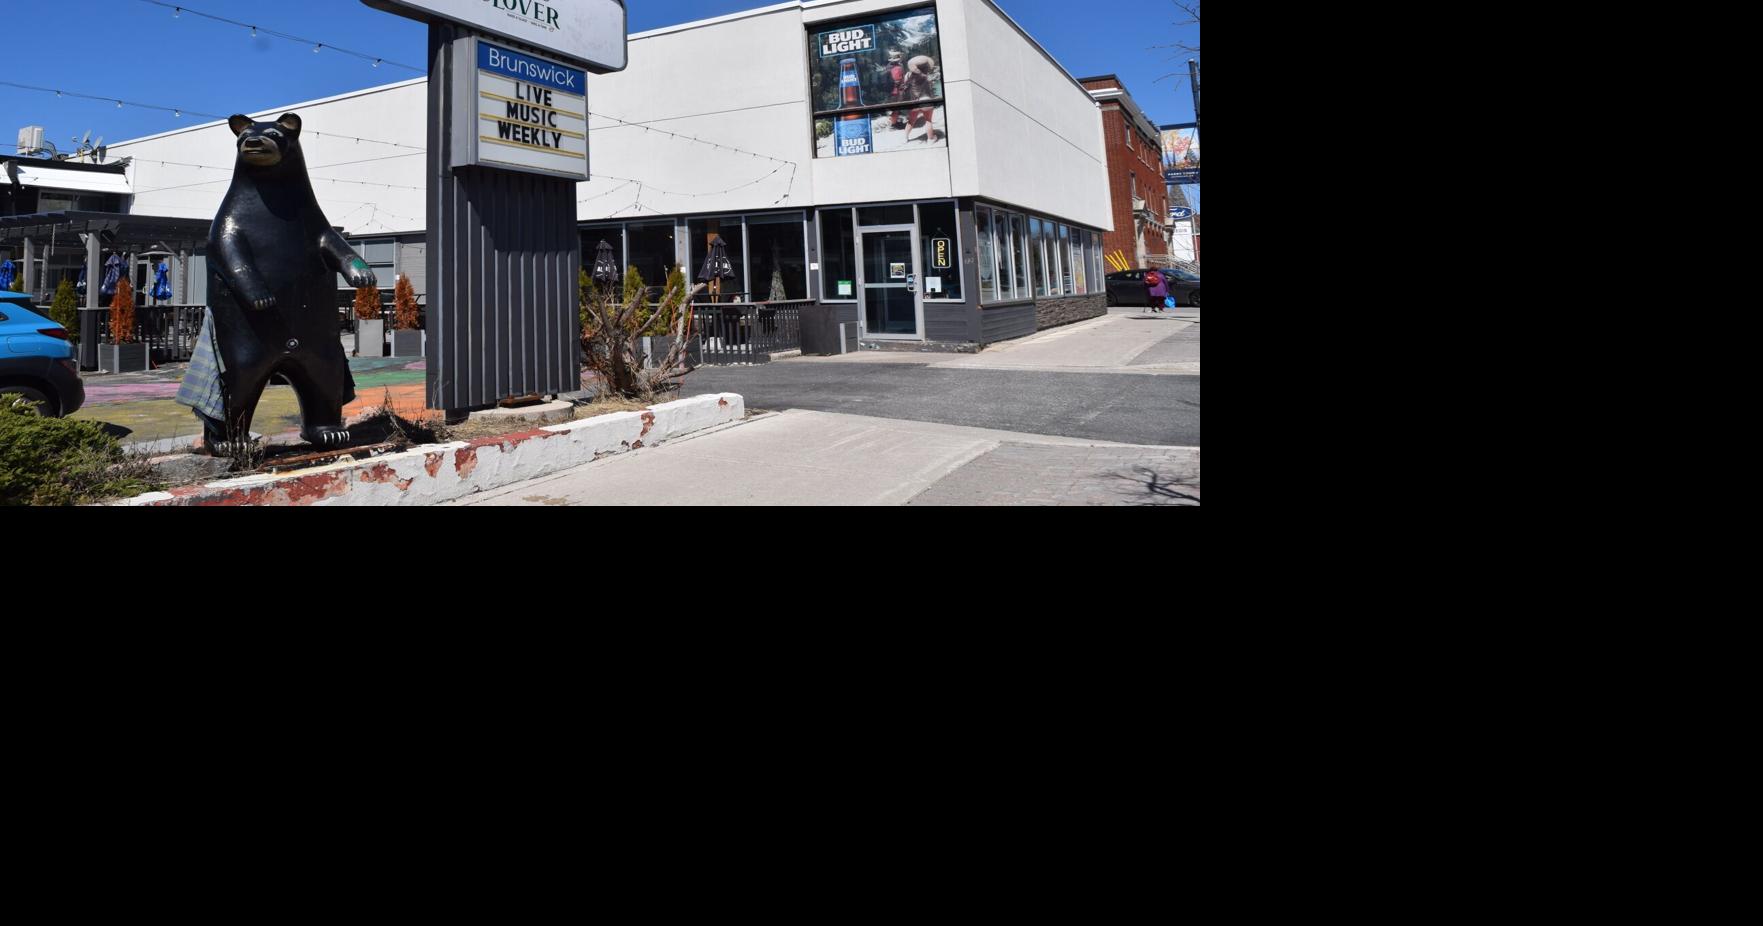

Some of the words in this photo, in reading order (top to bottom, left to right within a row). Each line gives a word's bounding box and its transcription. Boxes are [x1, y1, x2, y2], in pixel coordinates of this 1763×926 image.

[823, 37, 872, 55] LIGHT
[828, 29, 864, 44] BUD
[489, 48, 575, 88] Brunswick
[516, 82, 552, 107] LIVE
[506, 101, 557, 128] MUSIC
[497, 120, 562, 149] WEEKLY
[841, 137, 865, 147] BUD
[838, 144, 870, 154] LIGHT
[937, 241, 946, 265] OPEN
